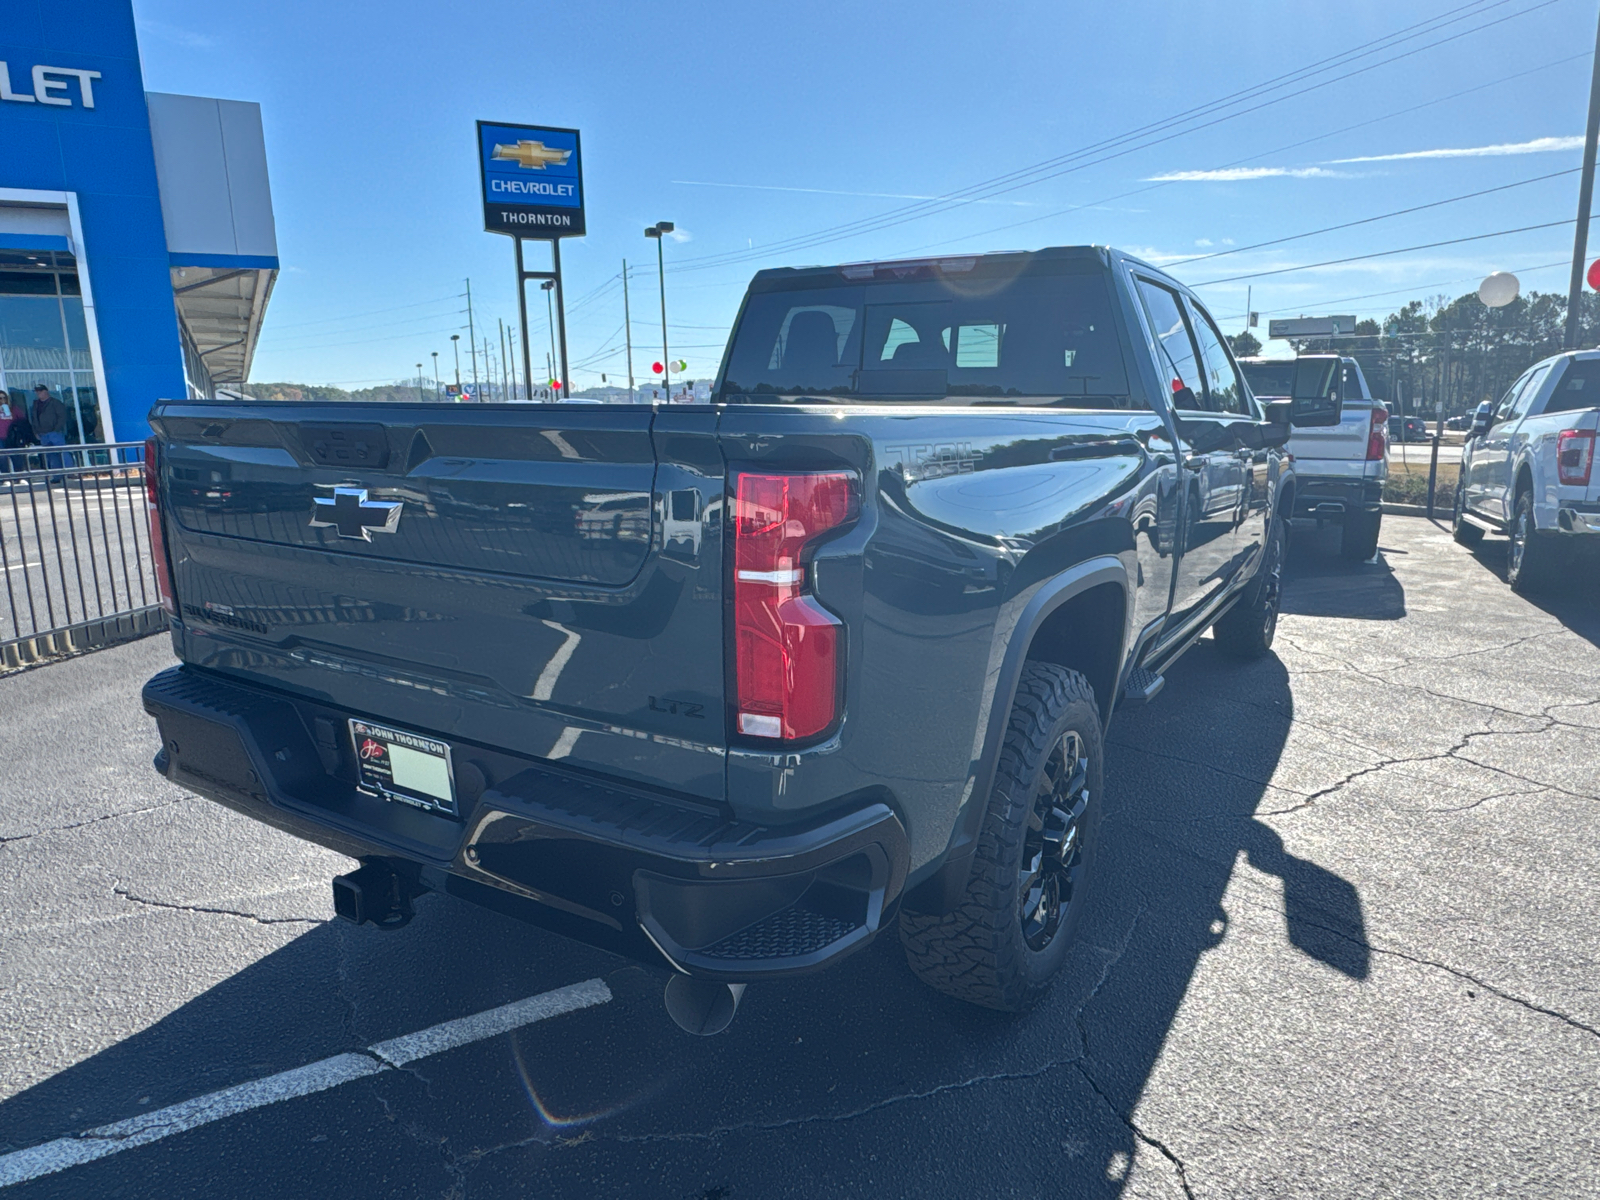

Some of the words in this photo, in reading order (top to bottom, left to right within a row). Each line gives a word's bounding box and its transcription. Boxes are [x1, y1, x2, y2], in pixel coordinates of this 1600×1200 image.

[0, 61, 102, 108] LET
[491, 180, 574, 196] CHEVROLET
[501, 212, 571, 226] THORNTON
[884, 442, 984, 464] TRAIL
[648, 695, 706, 720] LTZ
[371, 727, 395, 740] JOHN
[394, 733, 444, 754] THORNTON
